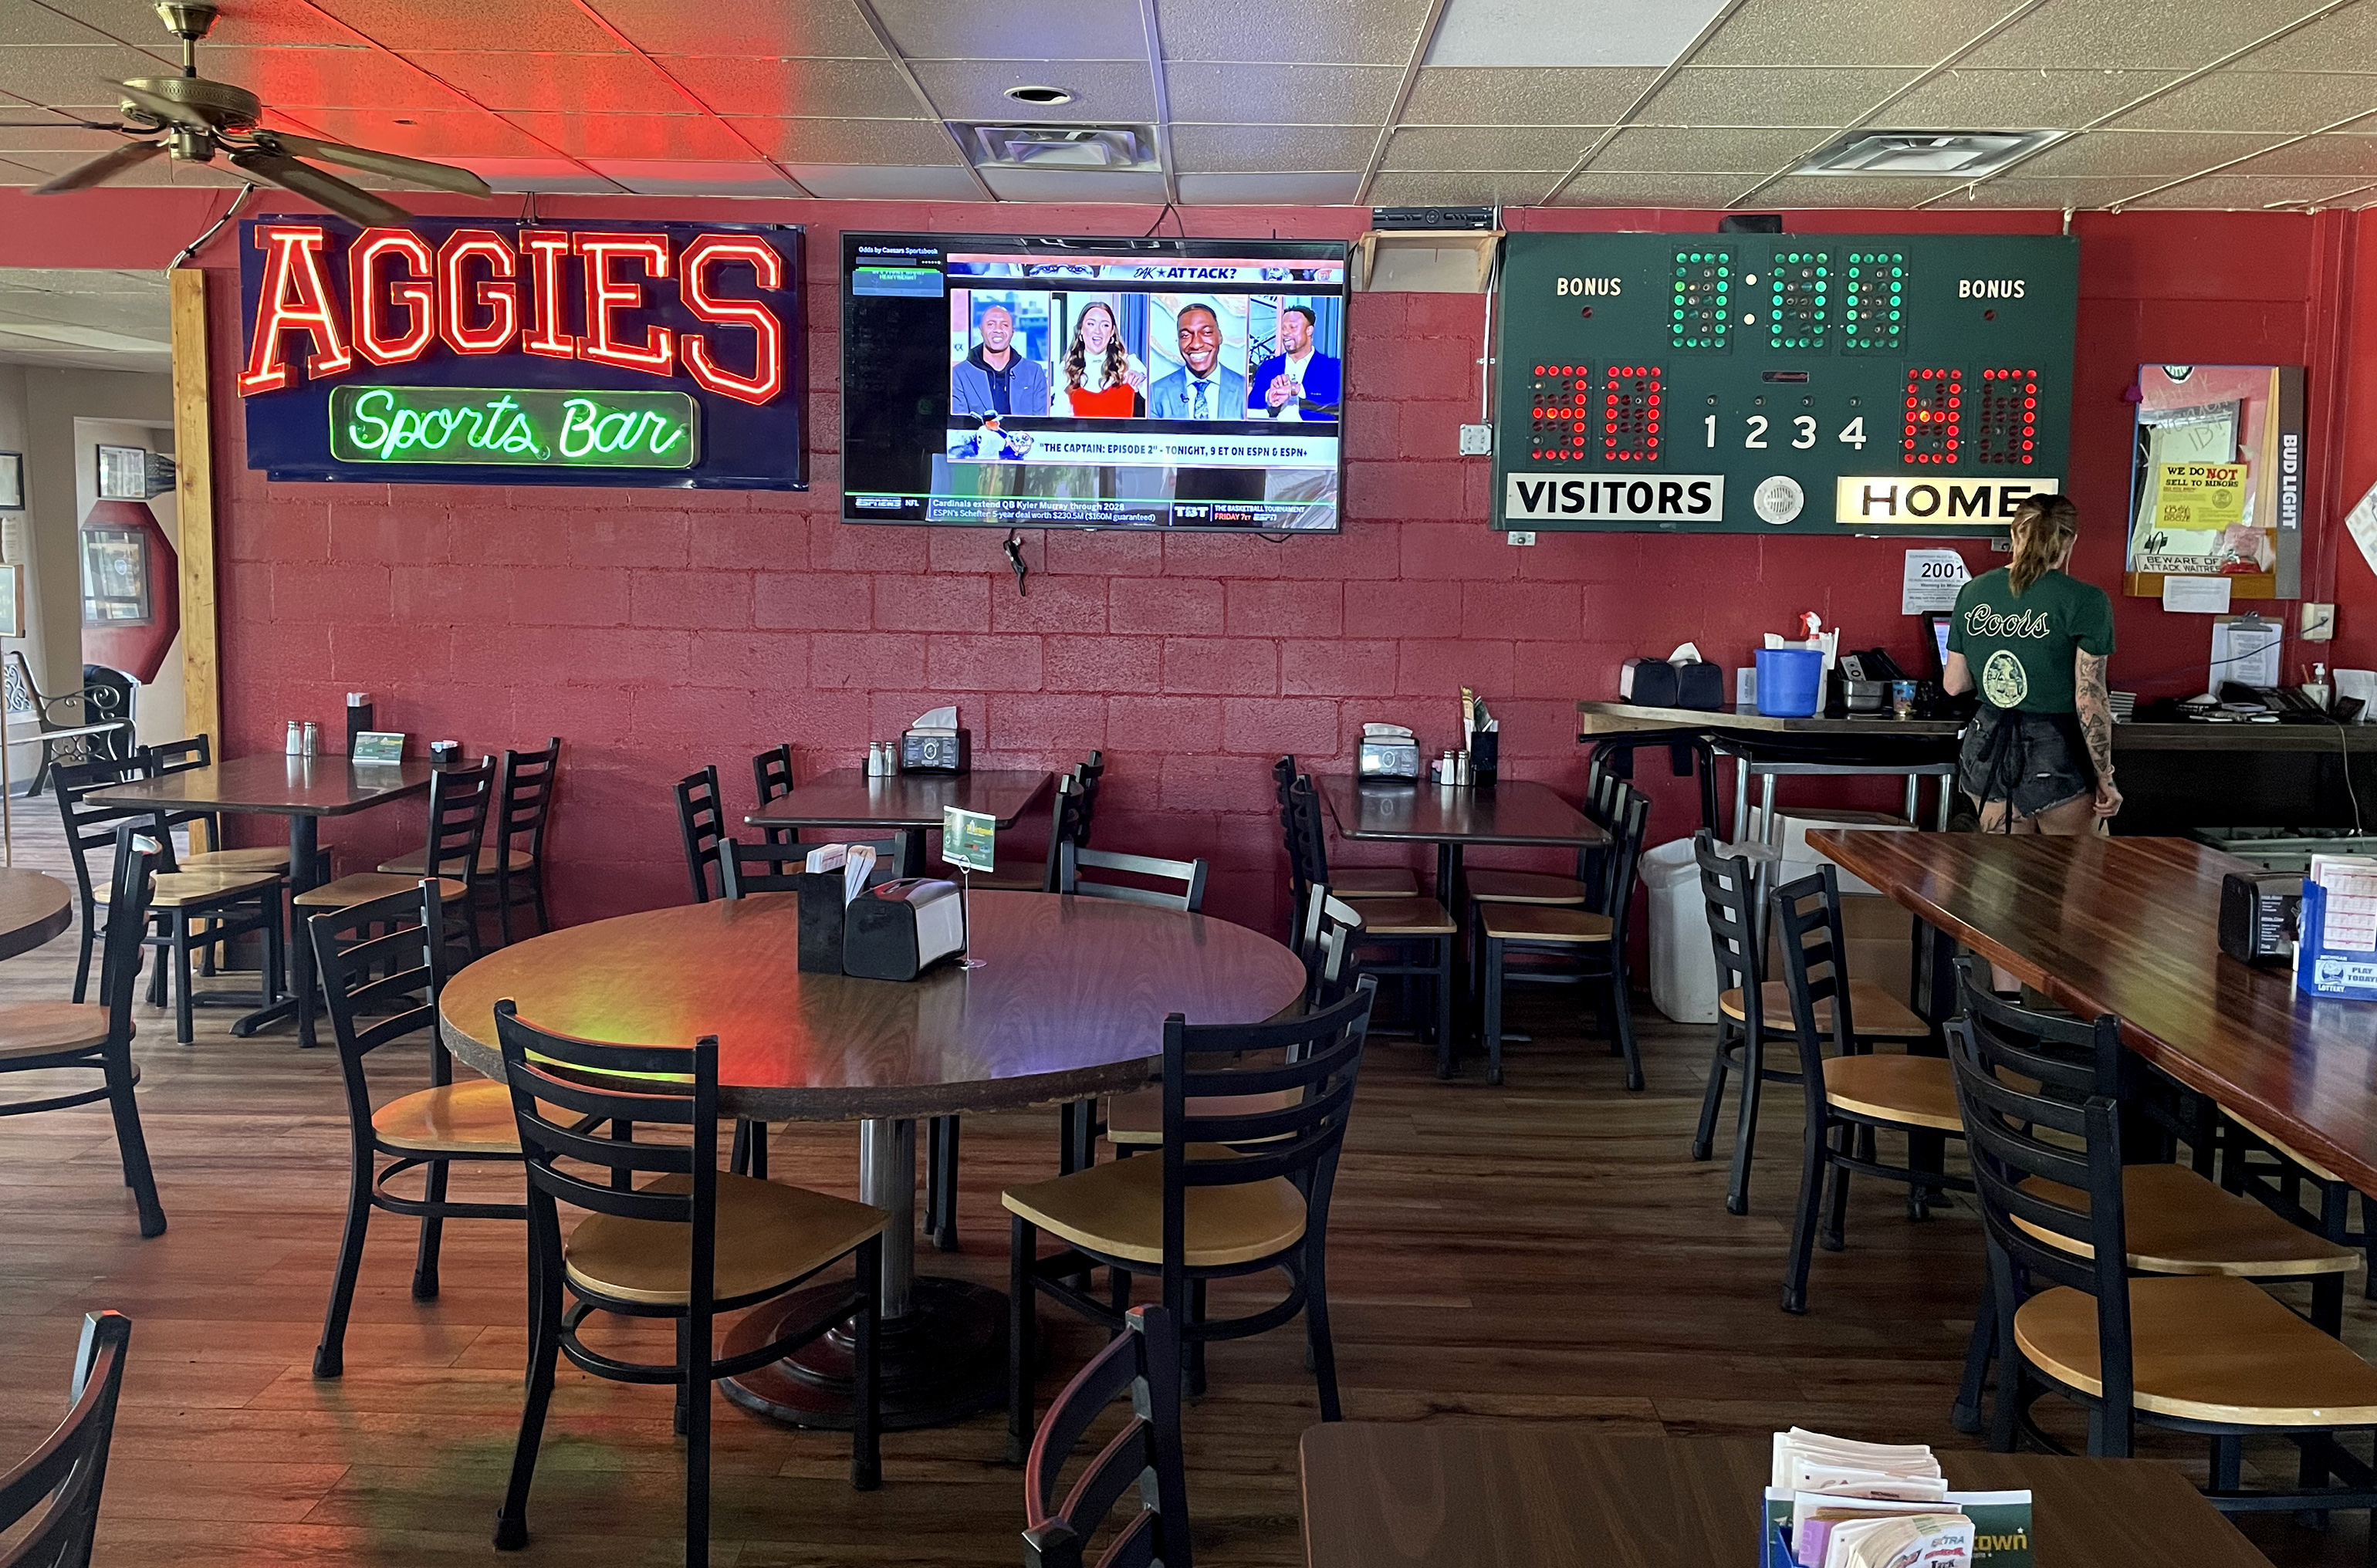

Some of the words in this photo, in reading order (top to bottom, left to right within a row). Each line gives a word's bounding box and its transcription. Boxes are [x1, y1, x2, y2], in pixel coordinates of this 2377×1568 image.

[1167, 267, 1237, 279] ATTACK?
[1557, 277, 1621, 296] BONUS
[1958, 279, 2025, 299] BONUS
[238, 225, 781, 407] AGGIES
[349, 390, 542, 460] Sports
[560, 398, 682, 458] Bar
[1705, 414, 1717, 448] 1
[1745, 415, 1768, 449] 2
[1791, 415, 1817, 449] 3
[1838, 416, 1867, 450] 4
[1063, 443, 1105, 454] CAPTAIN:
[1107, 444, 1145, 454] EPISODE
[1165, 445, 1209, 457] TONIGHT,
[1210, 447, 1216, 455] 9
[1218, 447, 1229, 455] ET
[1231, 447, 1244, 456] ON
[1247, 447, 1270, 456] ESPN
[1272, 448, 1278, 456] &
[1280, 448, 1307, 457] ESPN+
[2282, 434, 2298, 475] BUD
[2167, 467, 2186, 475] WE
[2189, 467, 2204, 475] DO
[2206, 468, 2238, 481] NOT
[972, 499, 1000, 508] extend
[1003, 500, 1015, 509] QB
[1016, 502, 1037, 511] Kyler
[1040, 502, 1067, 511] Murray
[1070, 502, 1101, 512] through
[1516, 481, 1713, 515] VISITORS
[1861, 485, 2031, 518] HOME
[2282, 475, 2298, 529] LIGHT
[992, 510, 1014, 519] 5-year
[1113, 513, 1156, 522] guaranteed)
[2143, 563, 2181, 572] ATTACK
[2146, 556, 2199, 565] BEWARE
[1921, 563, 1963, 579] 2001
[1964, 603, 2050, 639] Coors
[2318, 984, 2345, 993] LOTTERY
